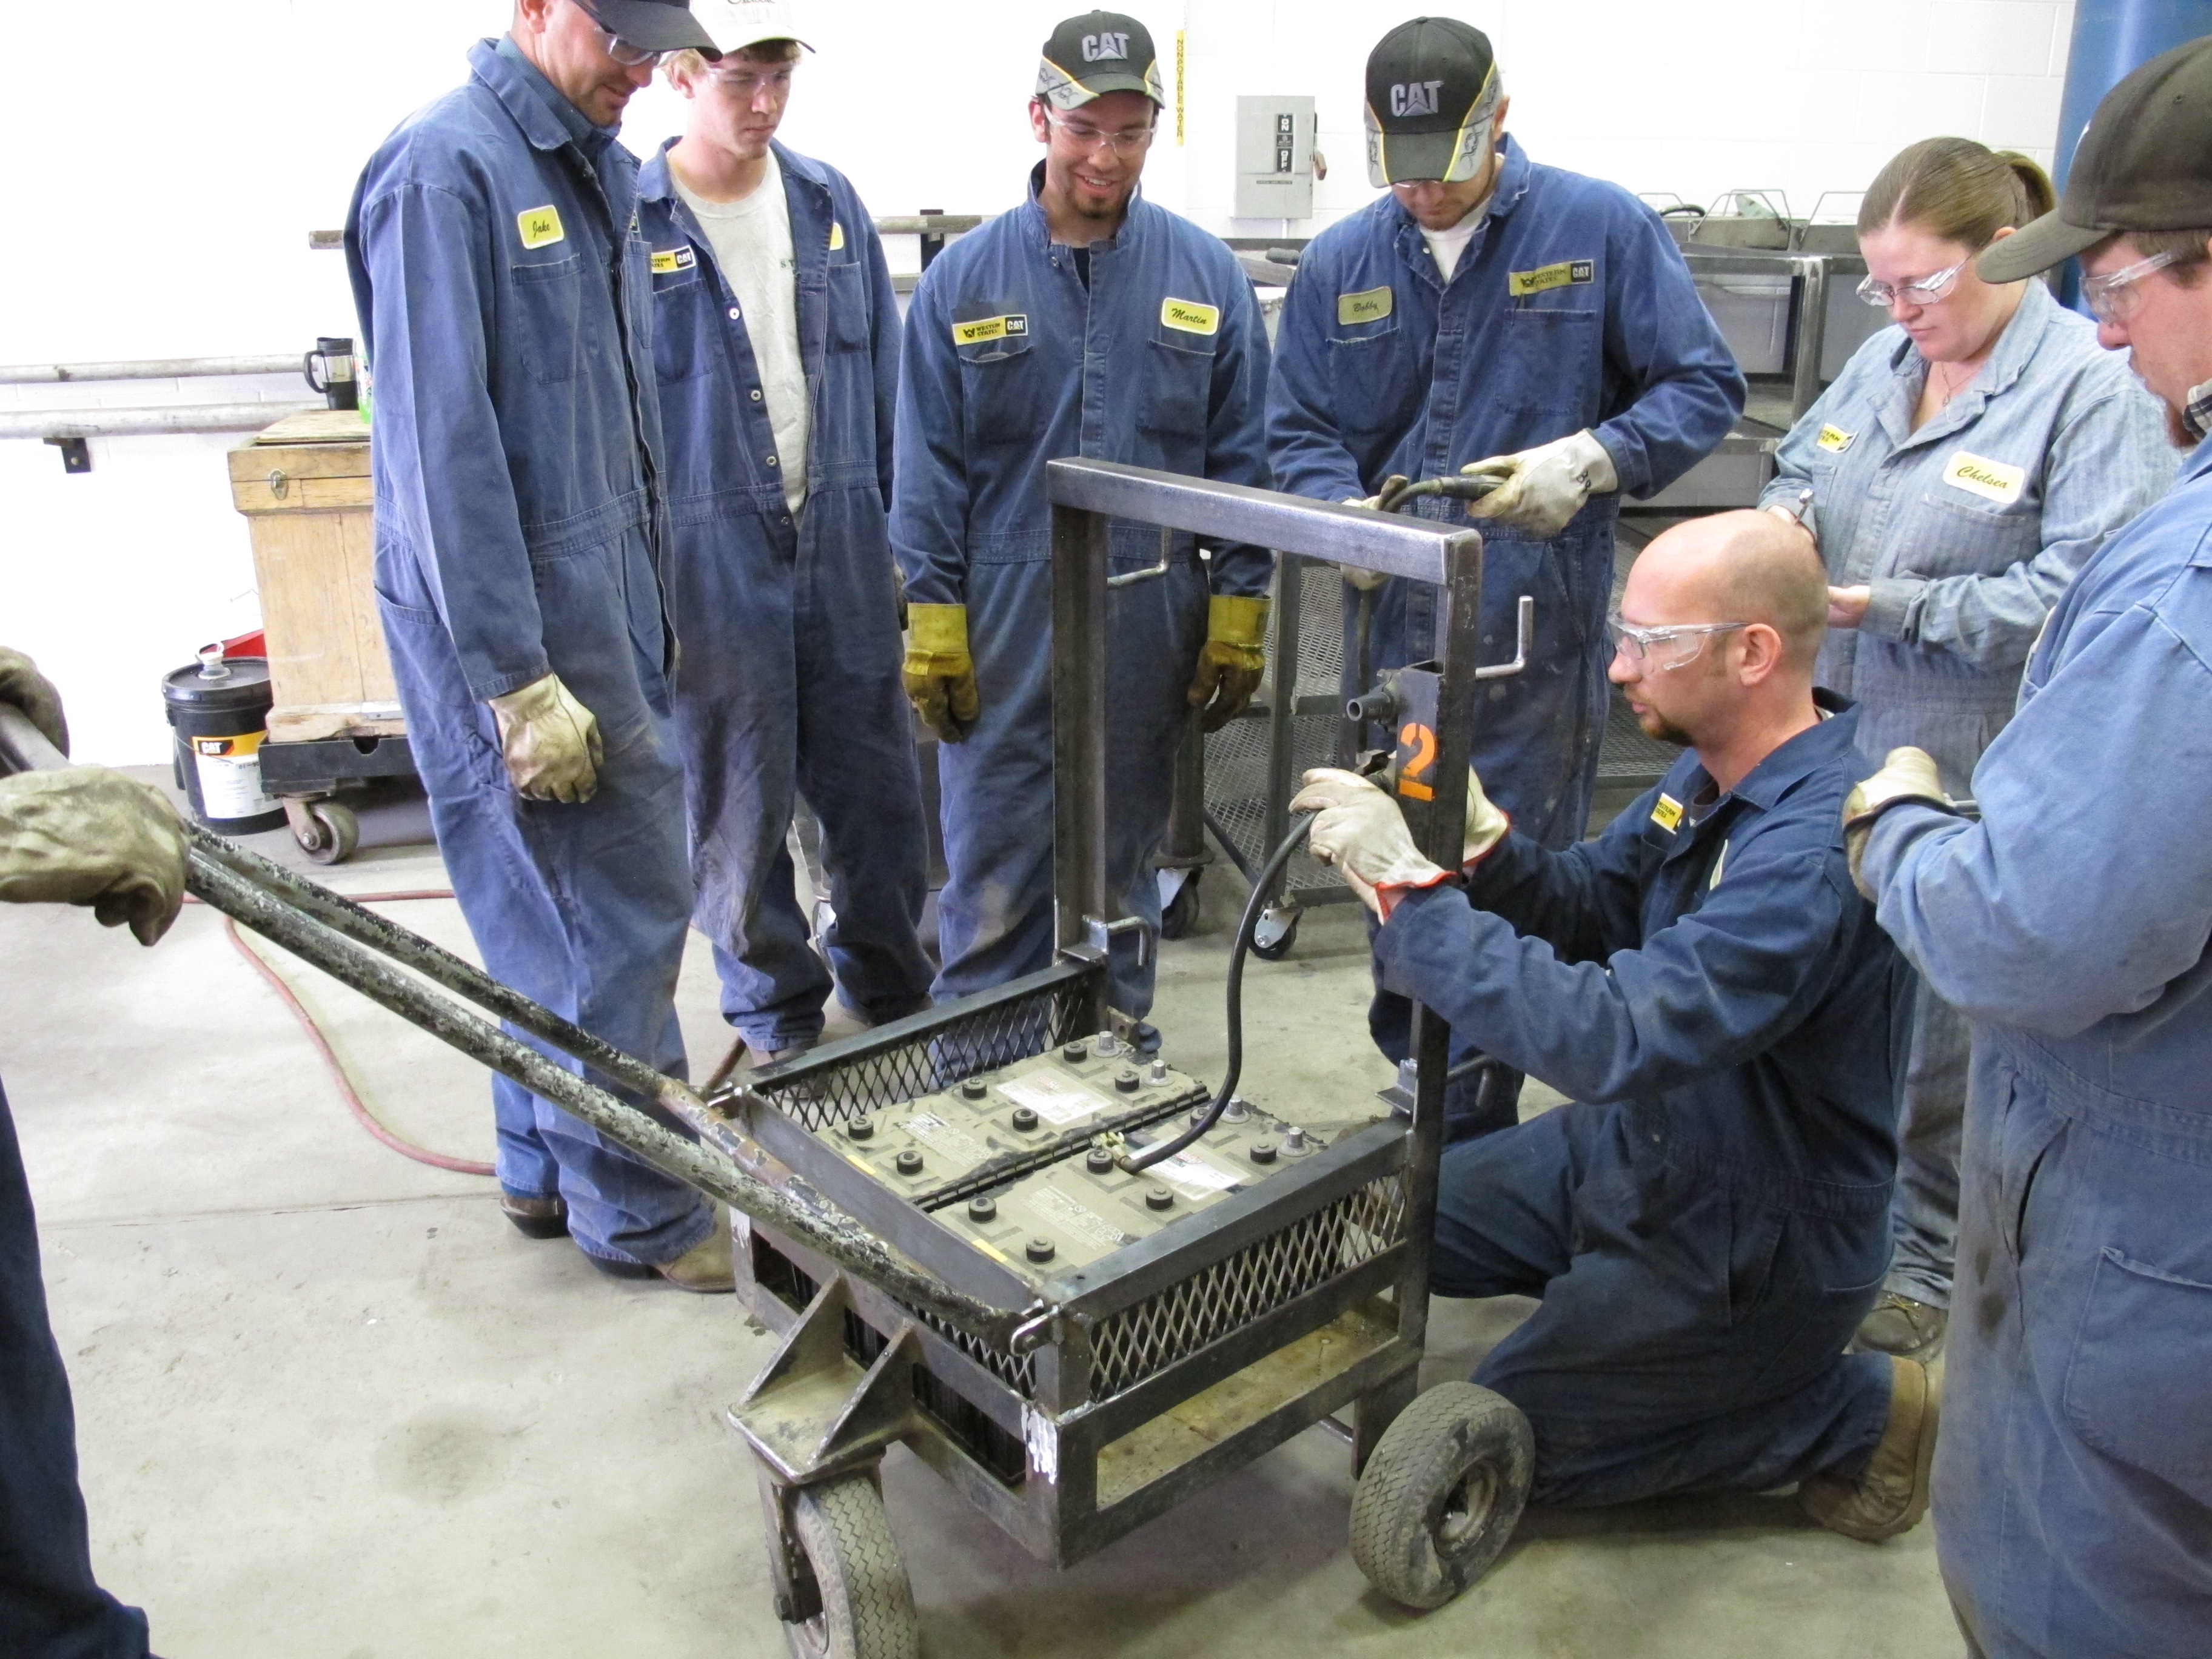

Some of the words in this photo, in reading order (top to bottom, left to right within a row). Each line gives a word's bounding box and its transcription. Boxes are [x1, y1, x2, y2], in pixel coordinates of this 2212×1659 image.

[1082, 33, 1130, 62] CAT
[1390, 81, 1444, 116] CAT
[1281, 118, 1289, 131] ON
[532, 220, 551, 238] Jake
[677, 252, 691, 264] CAT
[1572, 266, 1590, 278] CAT
[1007, 320, 1024, 330] CAT
[1171, 307, 1207, 325] Martin
[1956, 466, 2007, 489] Chelsea
[201, 742, 223, 754] CAT
[1399, 722, 1435, 802] 2
